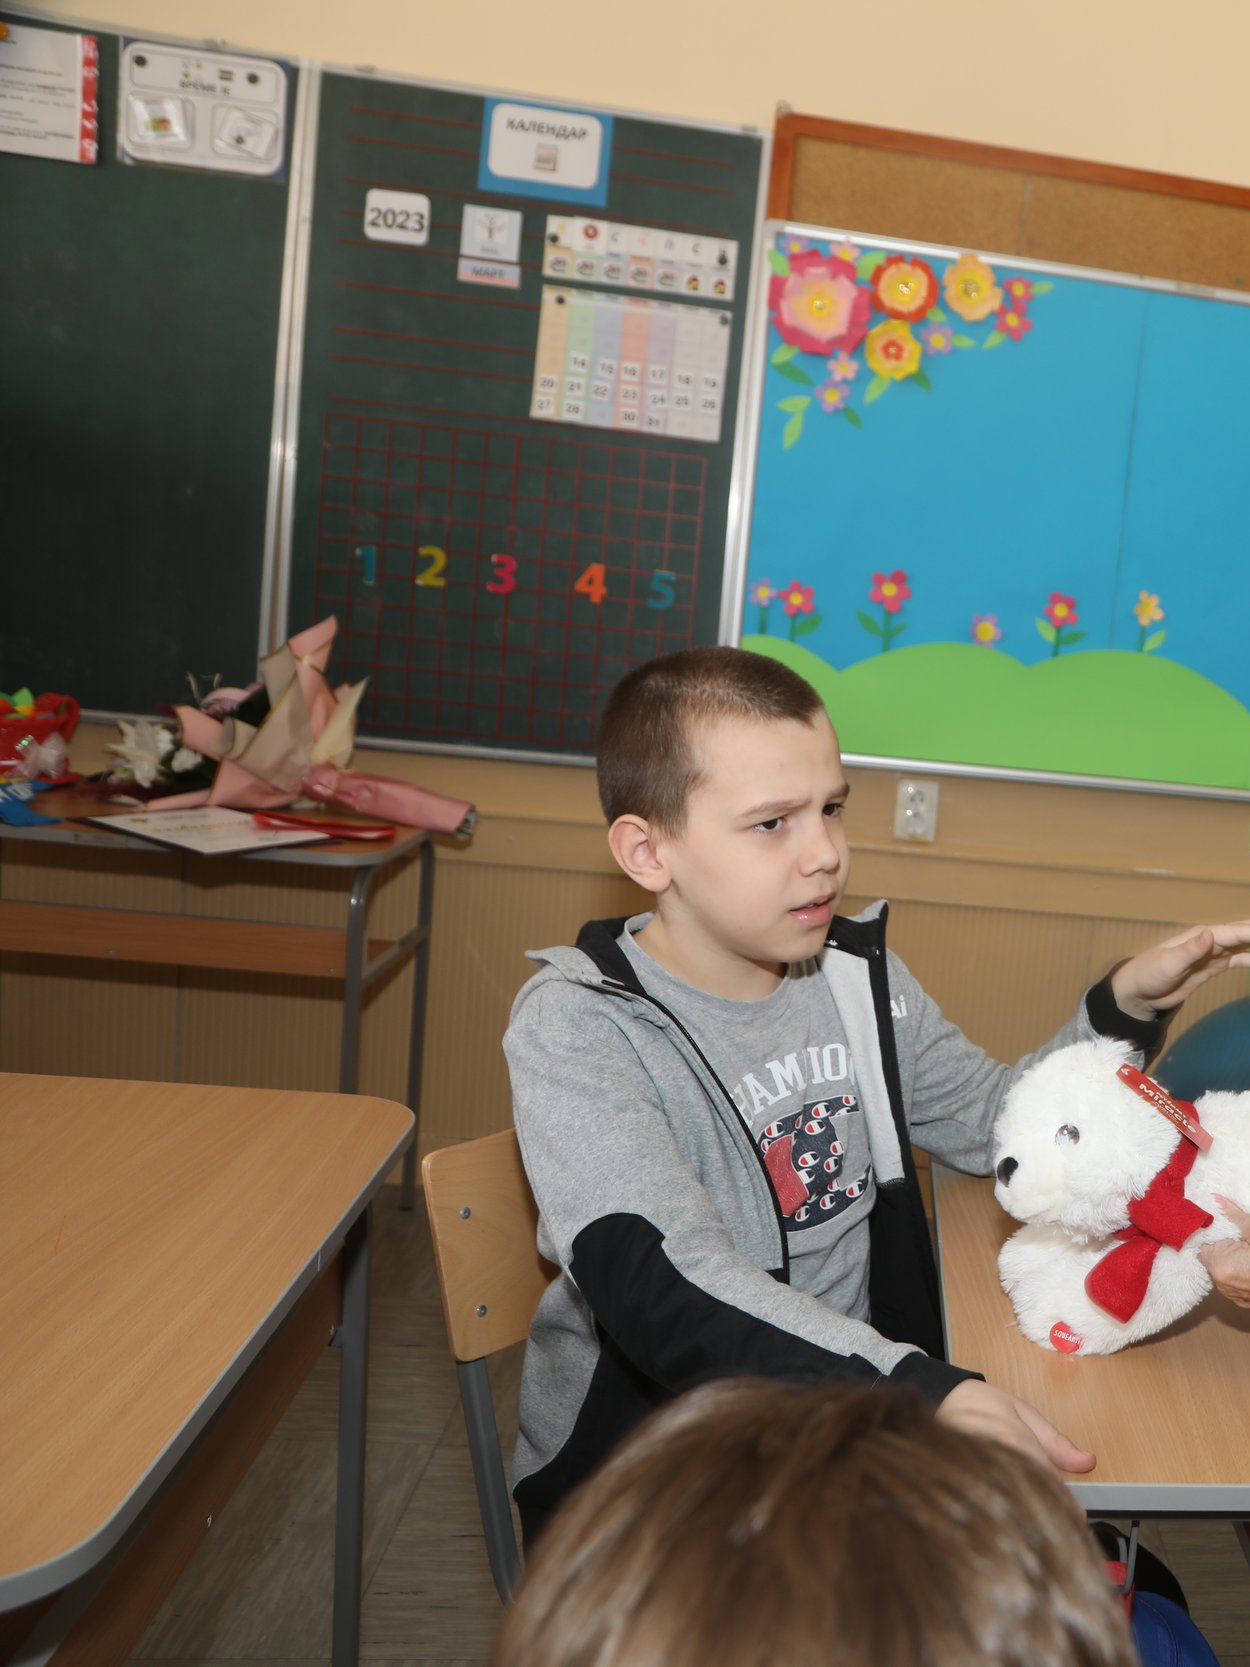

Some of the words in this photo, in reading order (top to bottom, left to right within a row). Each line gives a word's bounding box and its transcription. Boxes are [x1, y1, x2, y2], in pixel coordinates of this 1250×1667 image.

[506, 117, 588, 141] КАЛЕНДАР
[369, 207, 426, 233] 2023
[592, 384, 608, 397] 22
[355, 545, 378, 586] 1
[415, 546, 448, 588] 2
[486, 554, 518, 595] 3
[574, 563, 608, 604] 4
[646, 570, 677, 609] 5
[1138, 1083, 1197, 1134] Miracle
